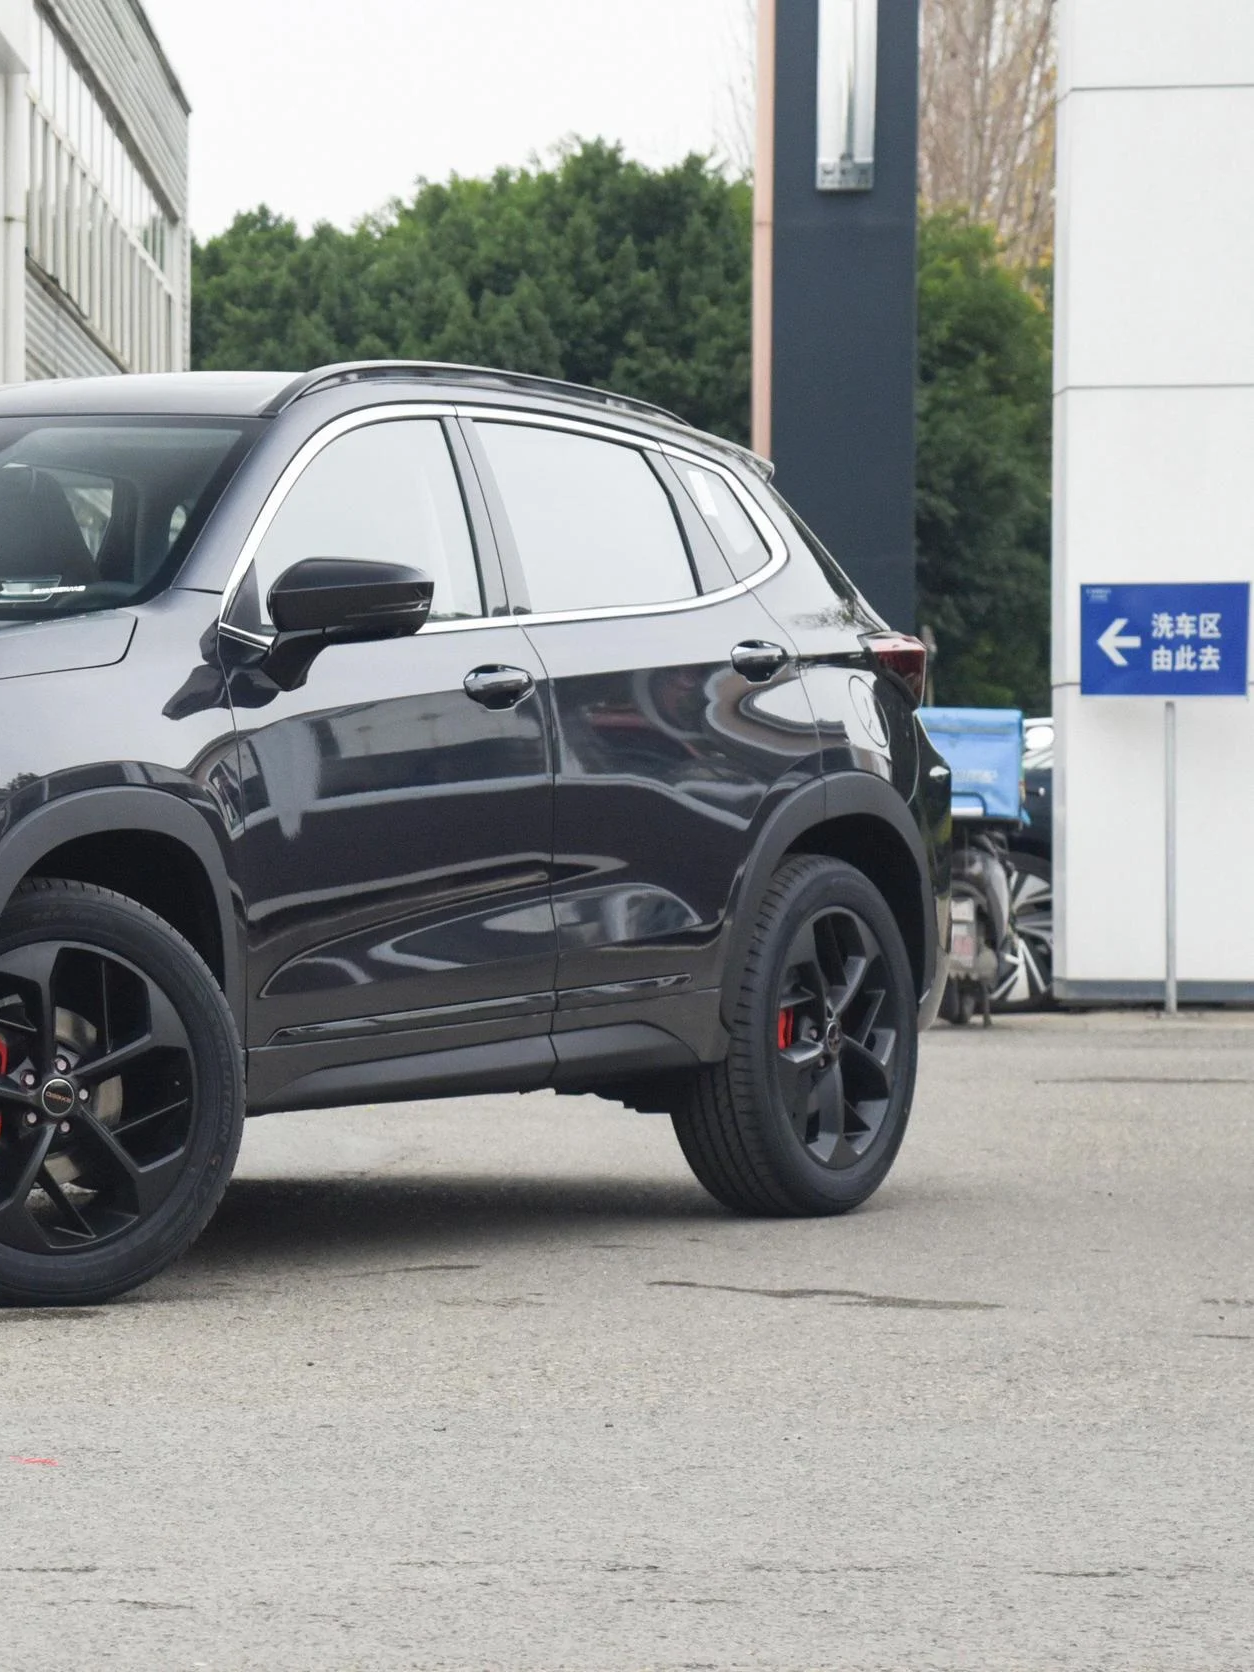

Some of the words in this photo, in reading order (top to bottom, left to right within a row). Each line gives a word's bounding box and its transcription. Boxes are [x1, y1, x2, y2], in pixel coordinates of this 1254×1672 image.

[1151, 612, 1222, 639] 洗车区
[1151, 645, 1221, 672] 由此去
